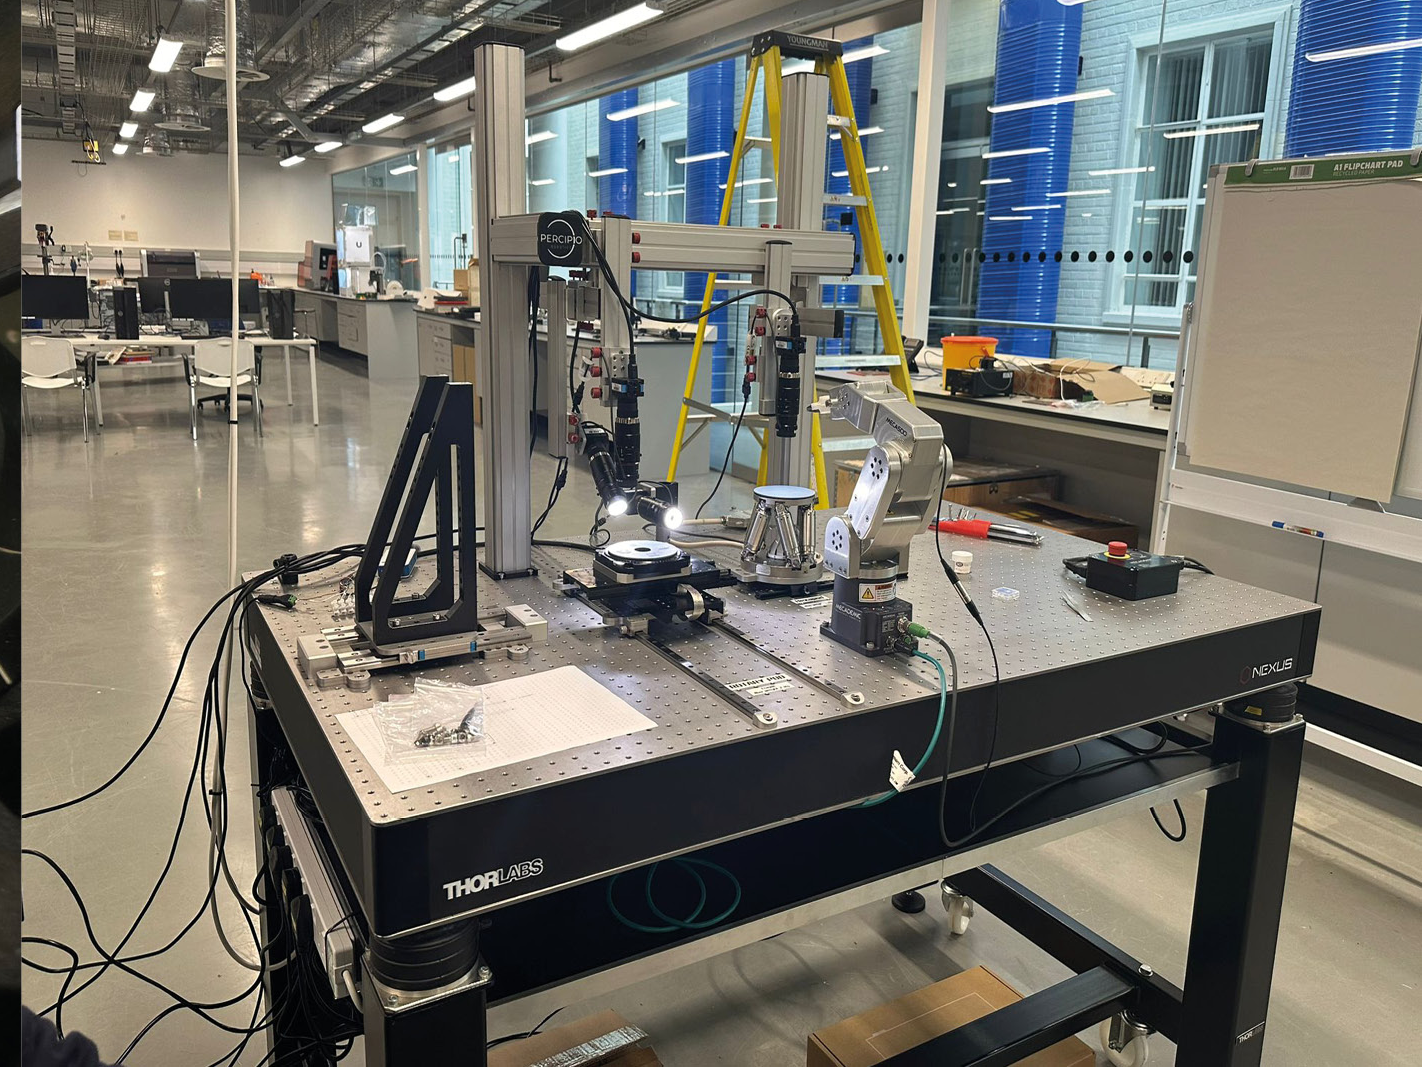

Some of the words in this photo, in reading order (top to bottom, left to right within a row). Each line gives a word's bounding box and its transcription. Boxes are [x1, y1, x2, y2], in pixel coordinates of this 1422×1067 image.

[787, 35, 828, 48] YOUNGMAN
[1334, 163, 1342, 171] A1
[1343, 161, 1386, 171] FLIPCHART
[1386, 160, 1404, 168] PAD
[540, 234, 582, 244] PERCIPIO
[886, 417, 908, 436] MECA500
[835, 604, 861, 619] MECADEMIC
[1252, 658, 1293, 678] NEXUS
[442, 858, 544, 900] THORLABS
